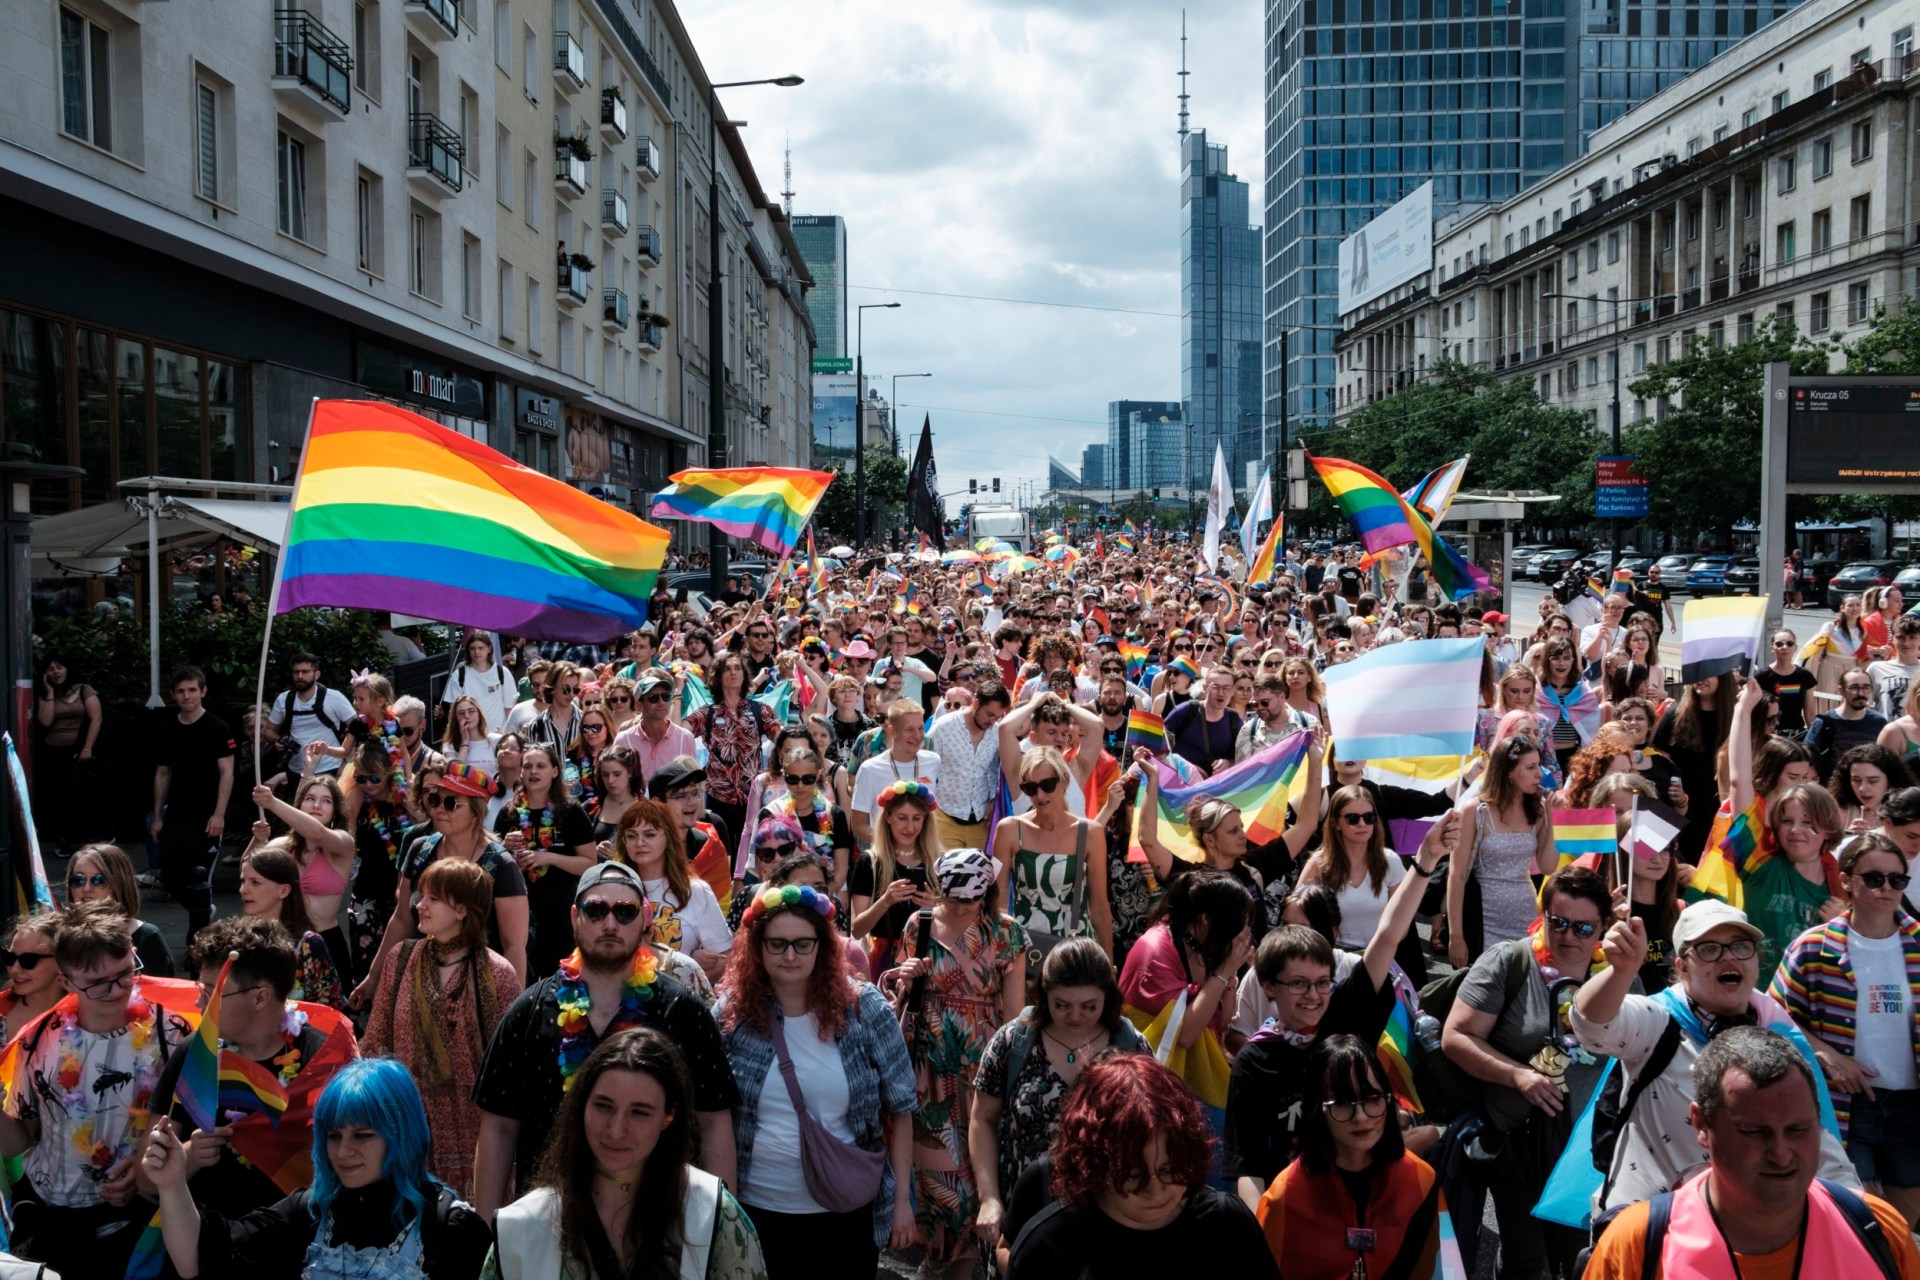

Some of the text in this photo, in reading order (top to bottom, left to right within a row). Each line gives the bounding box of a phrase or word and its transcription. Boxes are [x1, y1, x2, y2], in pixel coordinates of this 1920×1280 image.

[792, 217, 818, 225] arriott
[412, 369, 456, 403] monnari
[1810, 390, 1849, 400] Krucza 05
[1869, 991, 1902, 1001] BE PROUD
[1870, 1001, 1902, 1013] BE YOU
